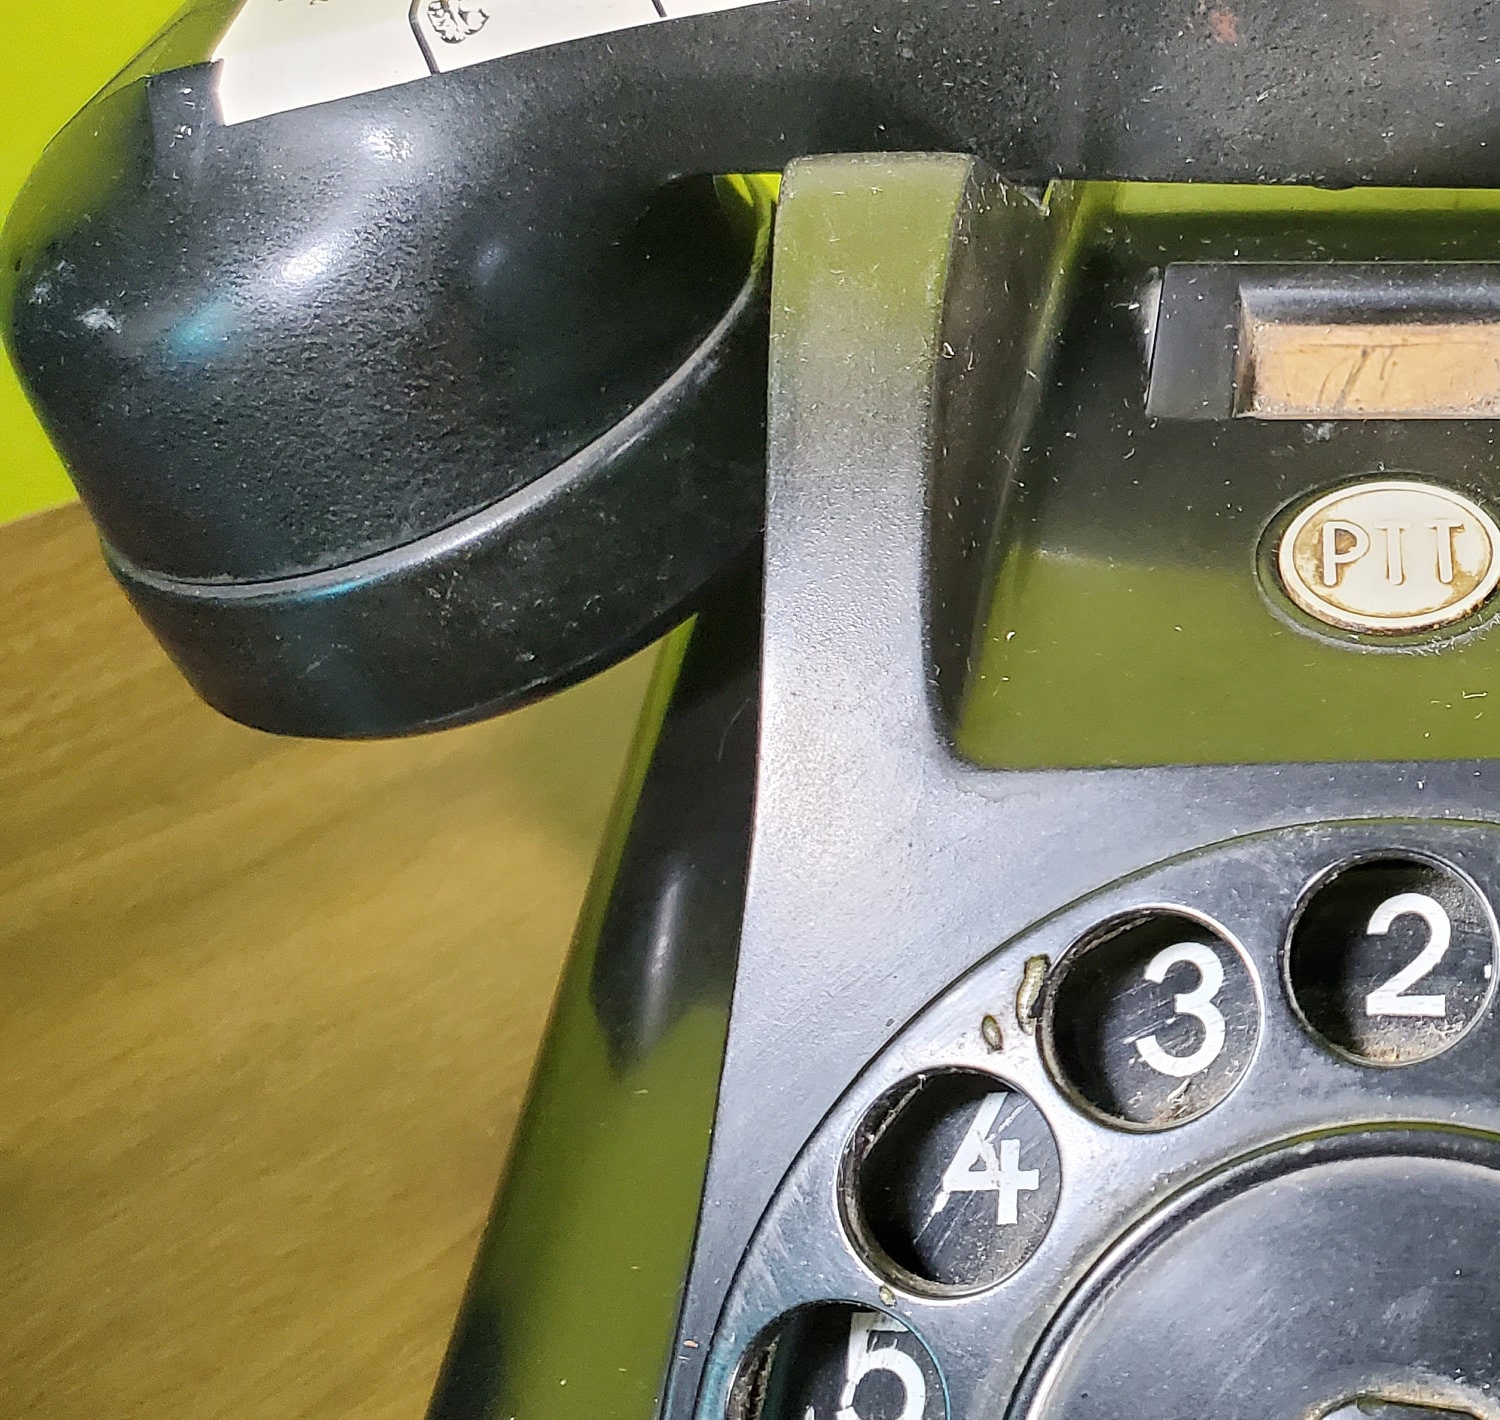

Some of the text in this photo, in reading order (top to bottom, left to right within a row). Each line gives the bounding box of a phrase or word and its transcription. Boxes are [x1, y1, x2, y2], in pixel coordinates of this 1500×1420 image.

[1320, 519, 1465, 586] PTT
[1134, 941, 1225, 1079] 3
[1365, 892, 1452, 1017] 2
[941, 1091, 1040, 1225] 4
[804, 1311, 926, 1420] 5
